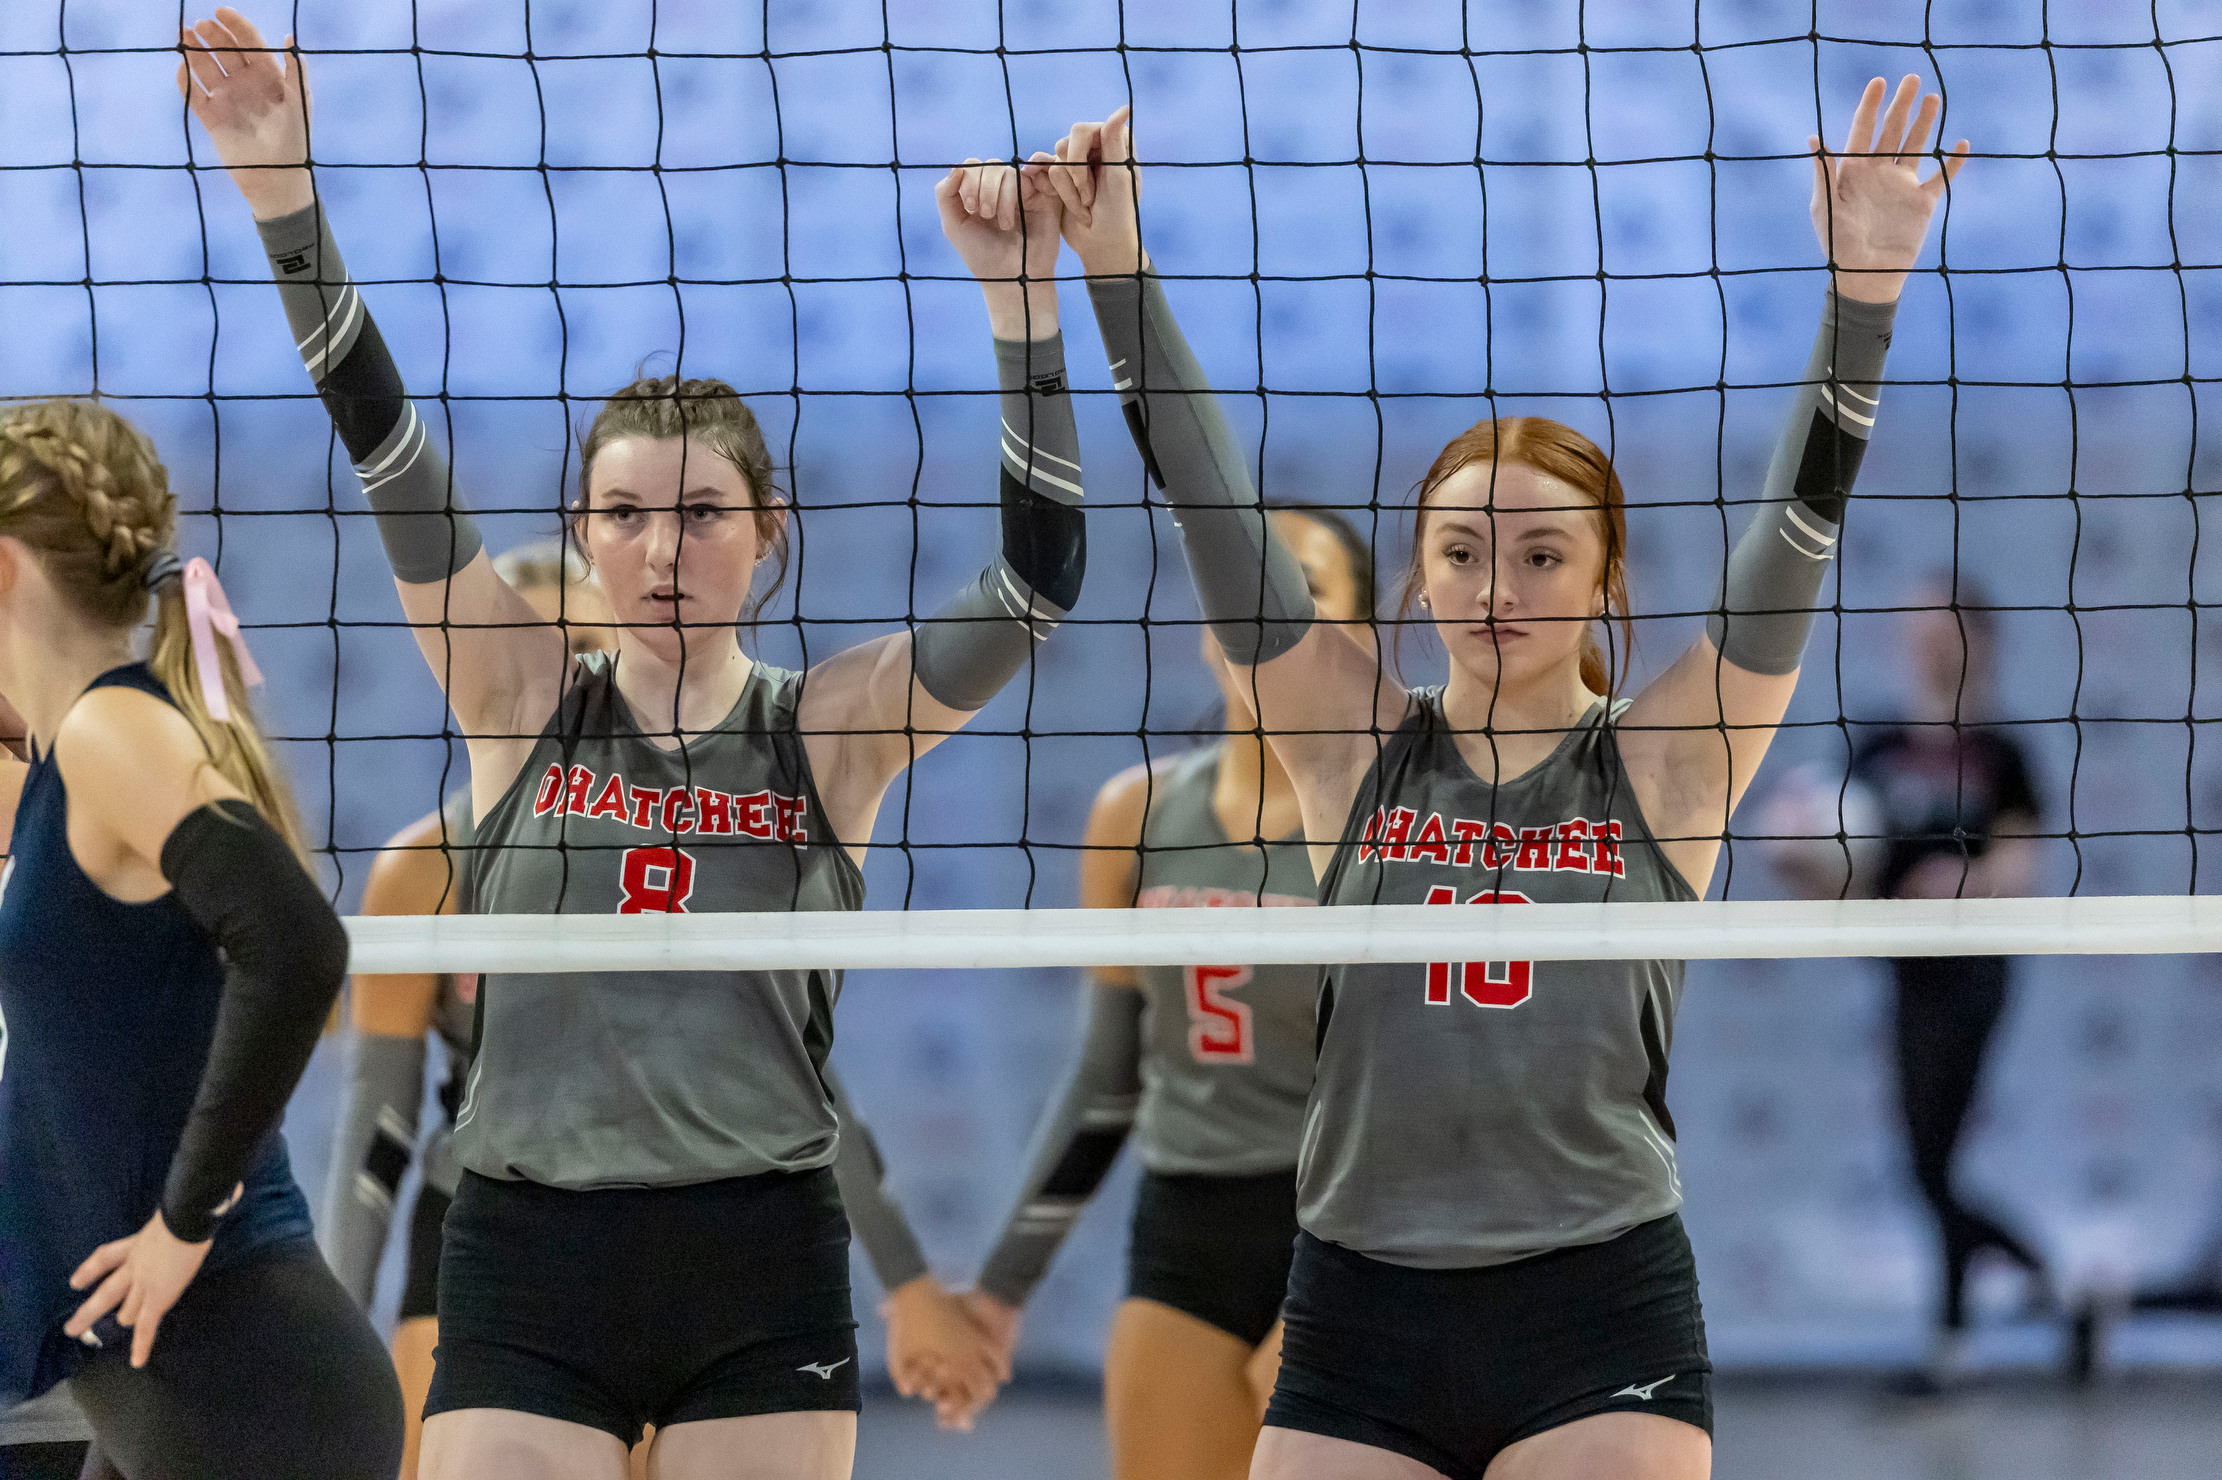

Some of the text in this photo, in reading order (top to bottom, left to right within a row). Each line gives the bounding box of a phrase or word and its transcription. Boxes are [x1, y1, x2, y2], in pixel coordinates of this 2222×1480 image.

[533, 762, 808, 850] OHATCHEE
[616, 843, 697, 914] 8
[1423, 885, 1536, 1009] 10
[1183, 965, 1254, 1065] 5
